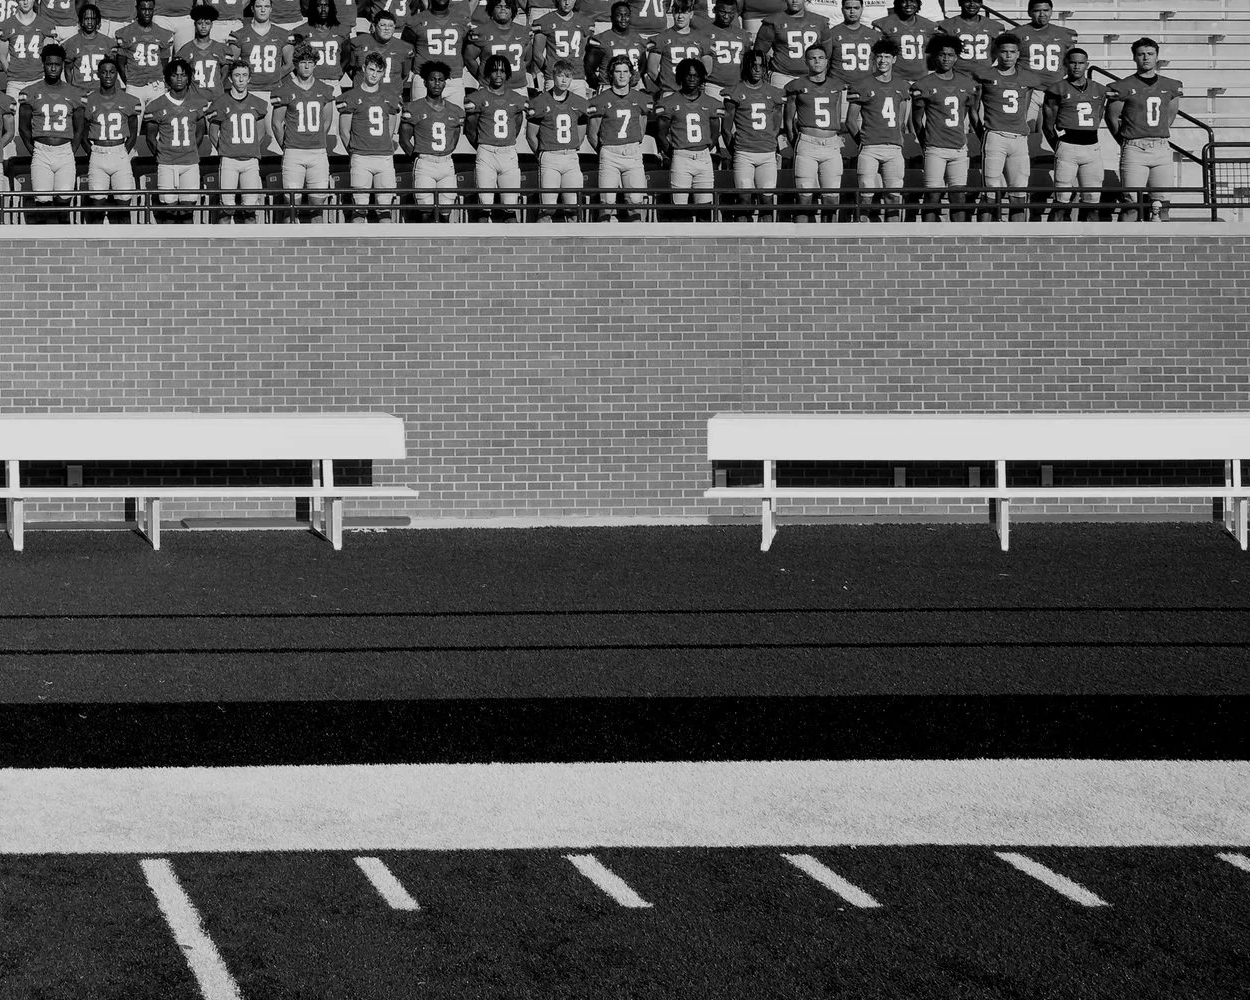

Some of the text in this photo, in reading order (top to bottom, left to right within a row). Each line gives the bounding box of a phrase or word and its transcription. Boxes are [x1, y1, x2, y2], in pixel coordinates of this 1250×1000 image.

[14, 35, 39, 58] 44
[133, 43, 158, 66] 46
[427, 29, 458, 55] 52
[555, 30, 581, 57] 54
[715, 41, 742, 63] 57
[787, 31, 817, 58] 58
[901, 35, 923, 59] 61
[250, 45, 277, 72] 48
[841, 43, 871, 70] 59
[1029, 44, 1060, 71] 66
[194, 60, 217, 88] 47
[814, 97, 830, 127] 5
[882, 97, 896, 127] 4
[945, 96, 959, 127] 3
[1003, 90, 1018, 113] 3
[1077, 102, 1093, 126] 2
[1147, 97, 1161, 126] 0
[42, 104, 68, 131] 13
[97, 113, 123, 140] 12
[230, 113, 254, 143] 10
[296, 101, 320, 132] 10
[369, 106, 383, 136] 9
[494, 110, 508, 138] 8
[556, 114, 571, 143] 8
[617, 109, 631, 138] 7
[686, 113, 702, 142] 6
[751, 103, 766, 130] 5
[171, 117, 190, 146] 11
[432, 122, 446, 151] 9
